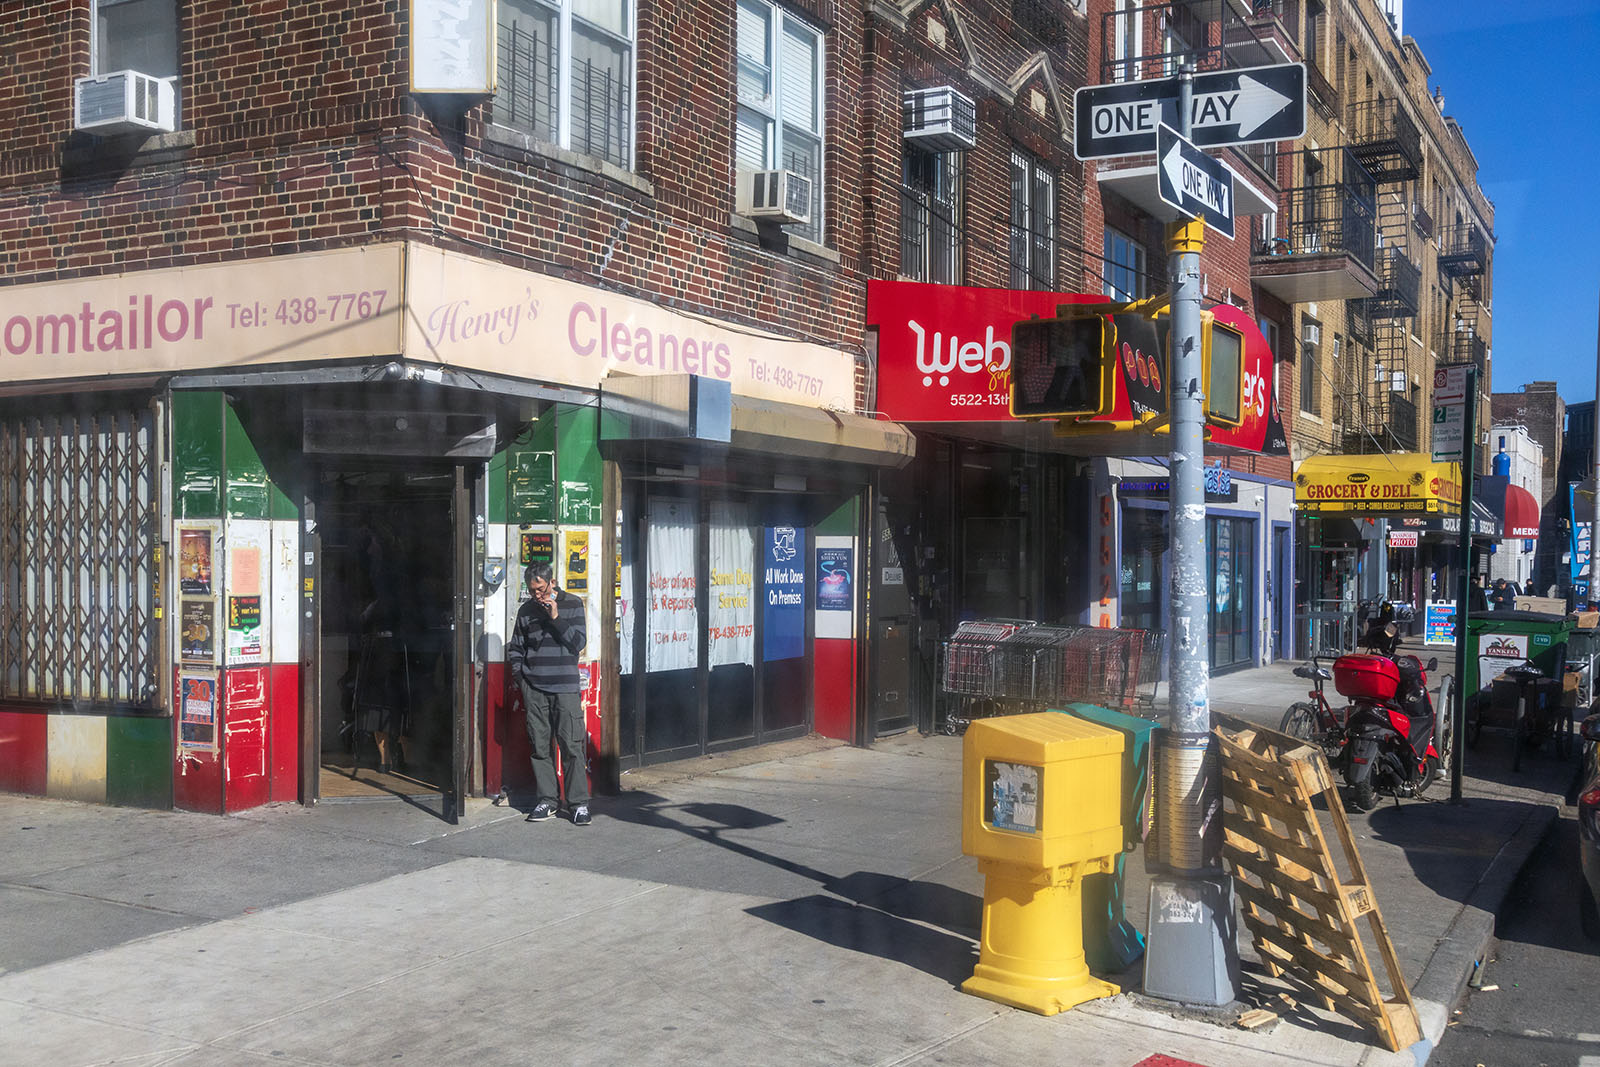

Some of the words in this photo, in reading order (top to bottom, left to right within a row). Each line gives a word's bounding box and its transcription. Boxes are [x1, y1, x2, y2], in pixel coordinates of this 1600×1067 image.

[1094, 103, 1154, 136] ONE
[1182, 162, 1203, 200] ONE
[1205, 172, 1227, 214] WAY
[0, 294, 213, 356] omtailor
[226, 302, 268, 329] Tel:
[275, 289, 388, 326] 438-7767
[426, 285, 543, 348] Henry's
[567, 301, 732, 380] Cleaners
[748, 357, 771, 385] Tel:
[773, 367, 824, 398] 438-7767
[1244, 358, 1265, 418] er's
[1436, 407, 1444, 423] 2
[1159, 482, 1171, 491] CA
[1307, 484, 1367, 499] GROCERY
[1370, 484, 1380, 498] &
[1383, 484, 1411, 498] DELI
[1512, 527, 1539, 536] MEDIC
[1390, 538, 1417, 546] PHOTO
[649, 571, 697, 590] Alterations
[711, 568, 735, 587] Same
[736, 569, 753, 590] Day
[765, 568, 773, 584] All
[774, 568, 789, 584] Work
[790, 568, 804, 584] Done
[661, 592, 694, 614] Repairs
[719, 592, 749, 610] Service
[769, 589, 778, 606] On
[778, 588, 802, 605] Premises
[708, 624, 753, 641] 718-438-7767
[187, 679, 210, 702] 30
